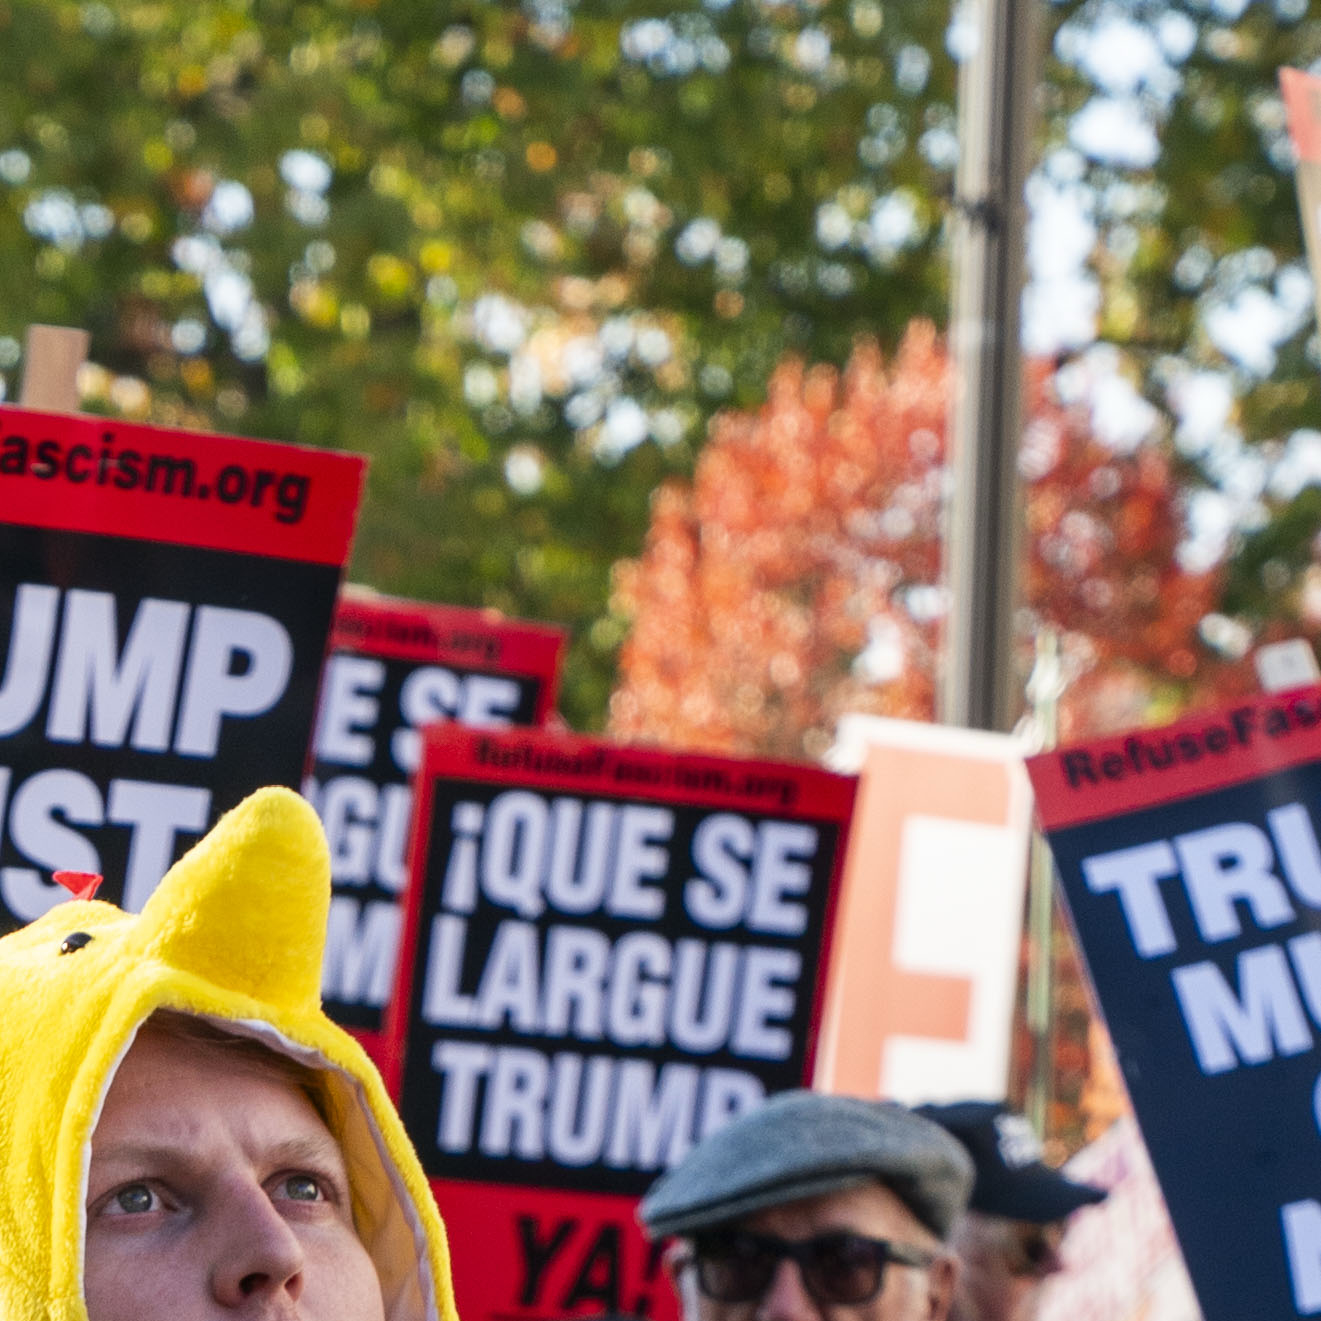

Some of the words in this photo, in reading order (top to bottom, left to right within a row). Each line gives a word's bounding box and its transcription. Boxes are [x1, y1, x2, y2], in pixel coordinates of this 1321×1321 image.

[441, 789, 675, 922] ¡QUE
[683, 812, 819, 937] SE
[422, 912, 802, 1062] LARGUE
[516, 1213, 666, 1316] YA!
